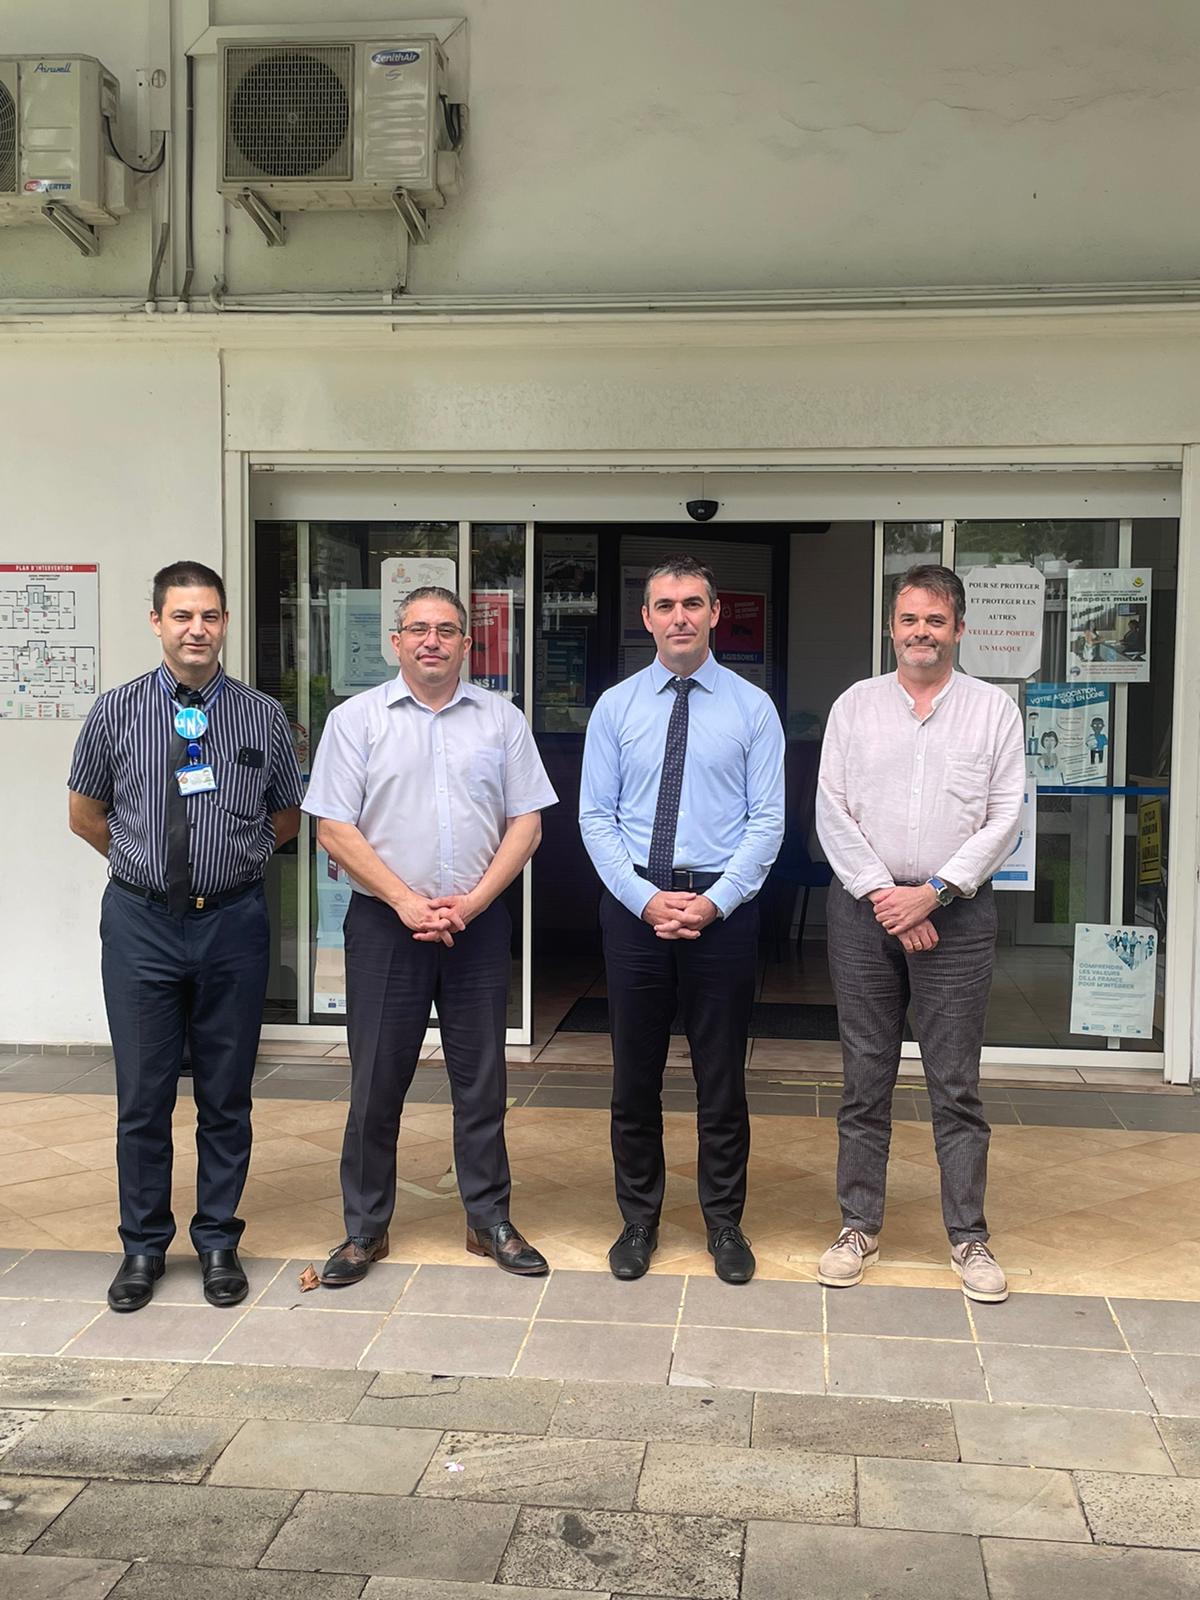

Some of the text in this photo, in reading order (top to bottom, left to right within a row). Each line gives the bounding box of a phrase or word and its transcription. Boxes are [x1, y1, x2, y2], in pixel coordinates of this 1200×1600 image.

[375, 52, 418, 63] ZenithAir
[33, 62, 72, 73] Airwell
[1113, 595, 1148, 603] mutuel
[1030, 686, 1097, 705] VOTRE ASSOCIATION
